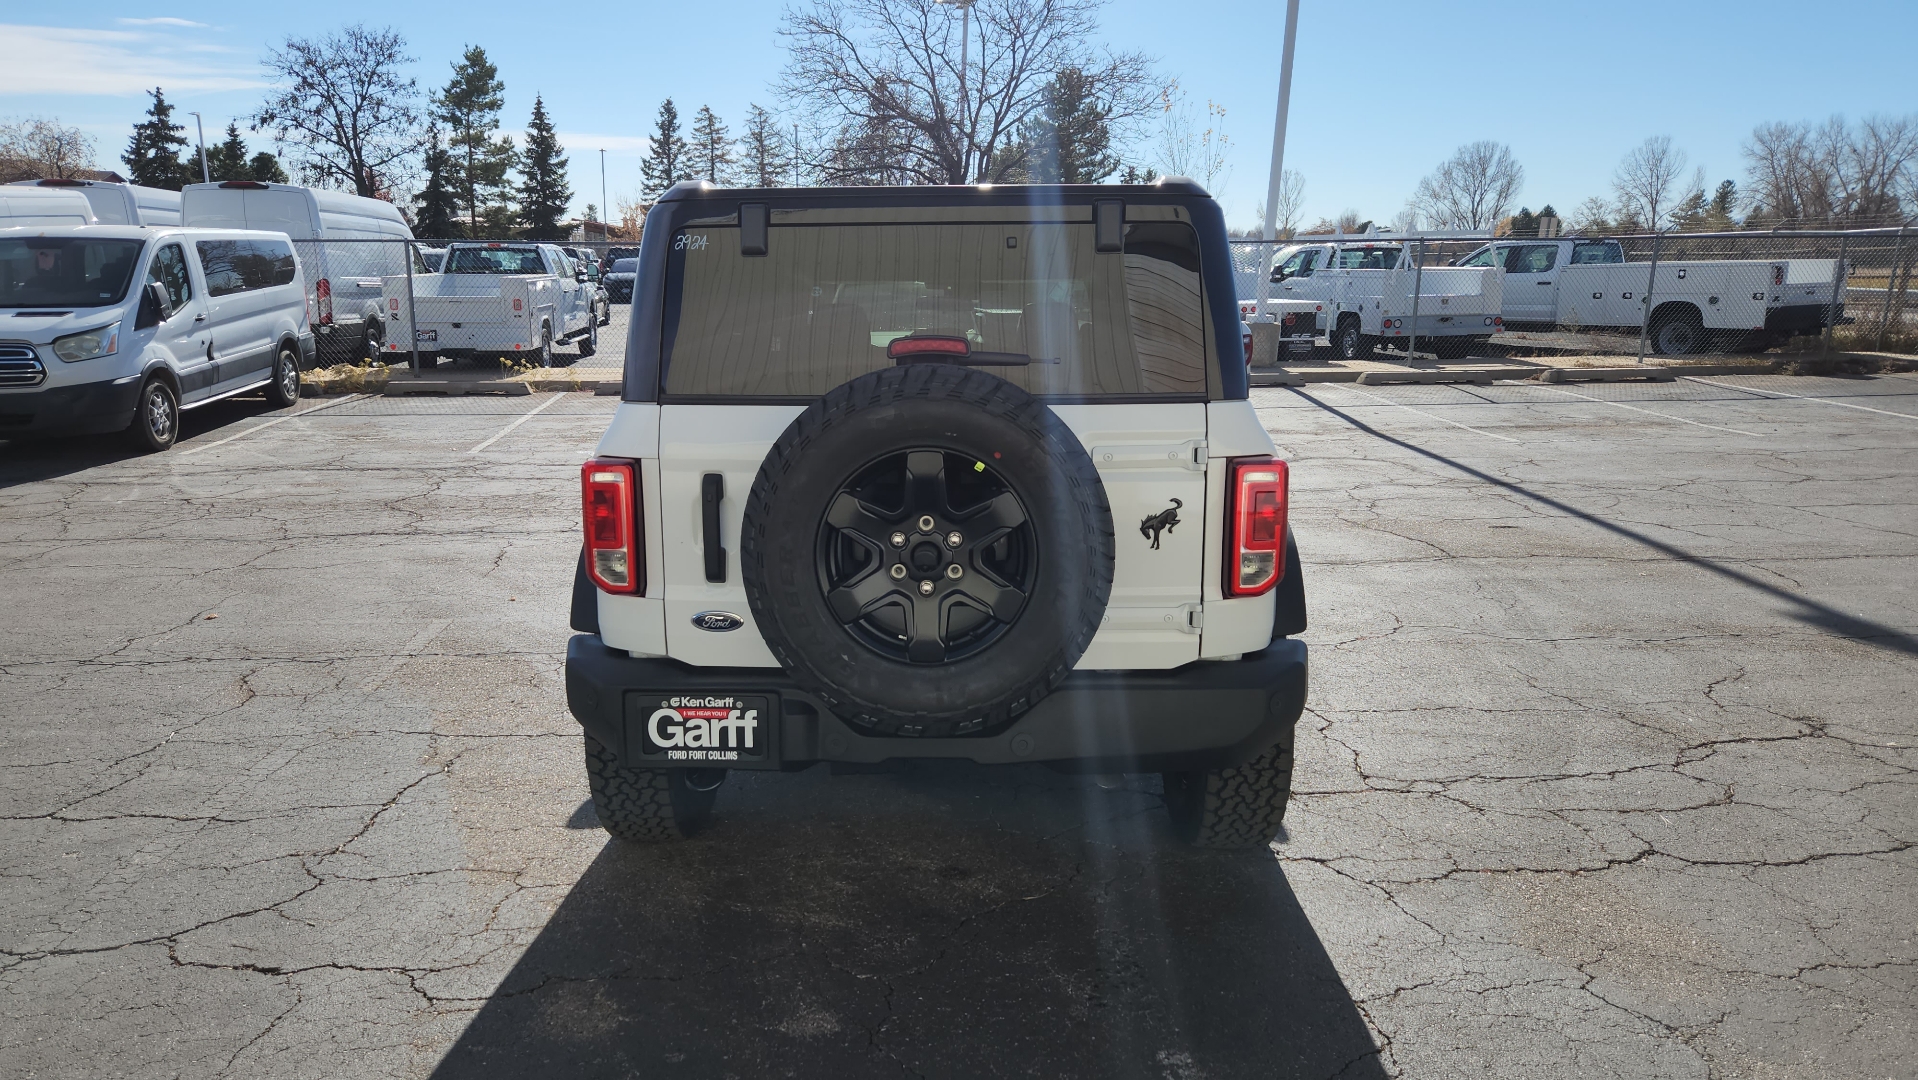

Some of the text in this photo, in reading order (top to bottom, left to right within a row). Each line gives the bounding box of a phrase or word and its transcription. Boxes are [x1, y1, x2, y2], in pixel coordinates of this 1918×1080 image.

[674, 234, 709, 250] 2924
[702, 615, 731, 628] Ford
[681, 696, 704, 707] Ken
[704, 696, 734, 708] Garff
[648, 708, 757, 748] Garff
[668, 750, 738, 761] FORD FORT COLLINS
